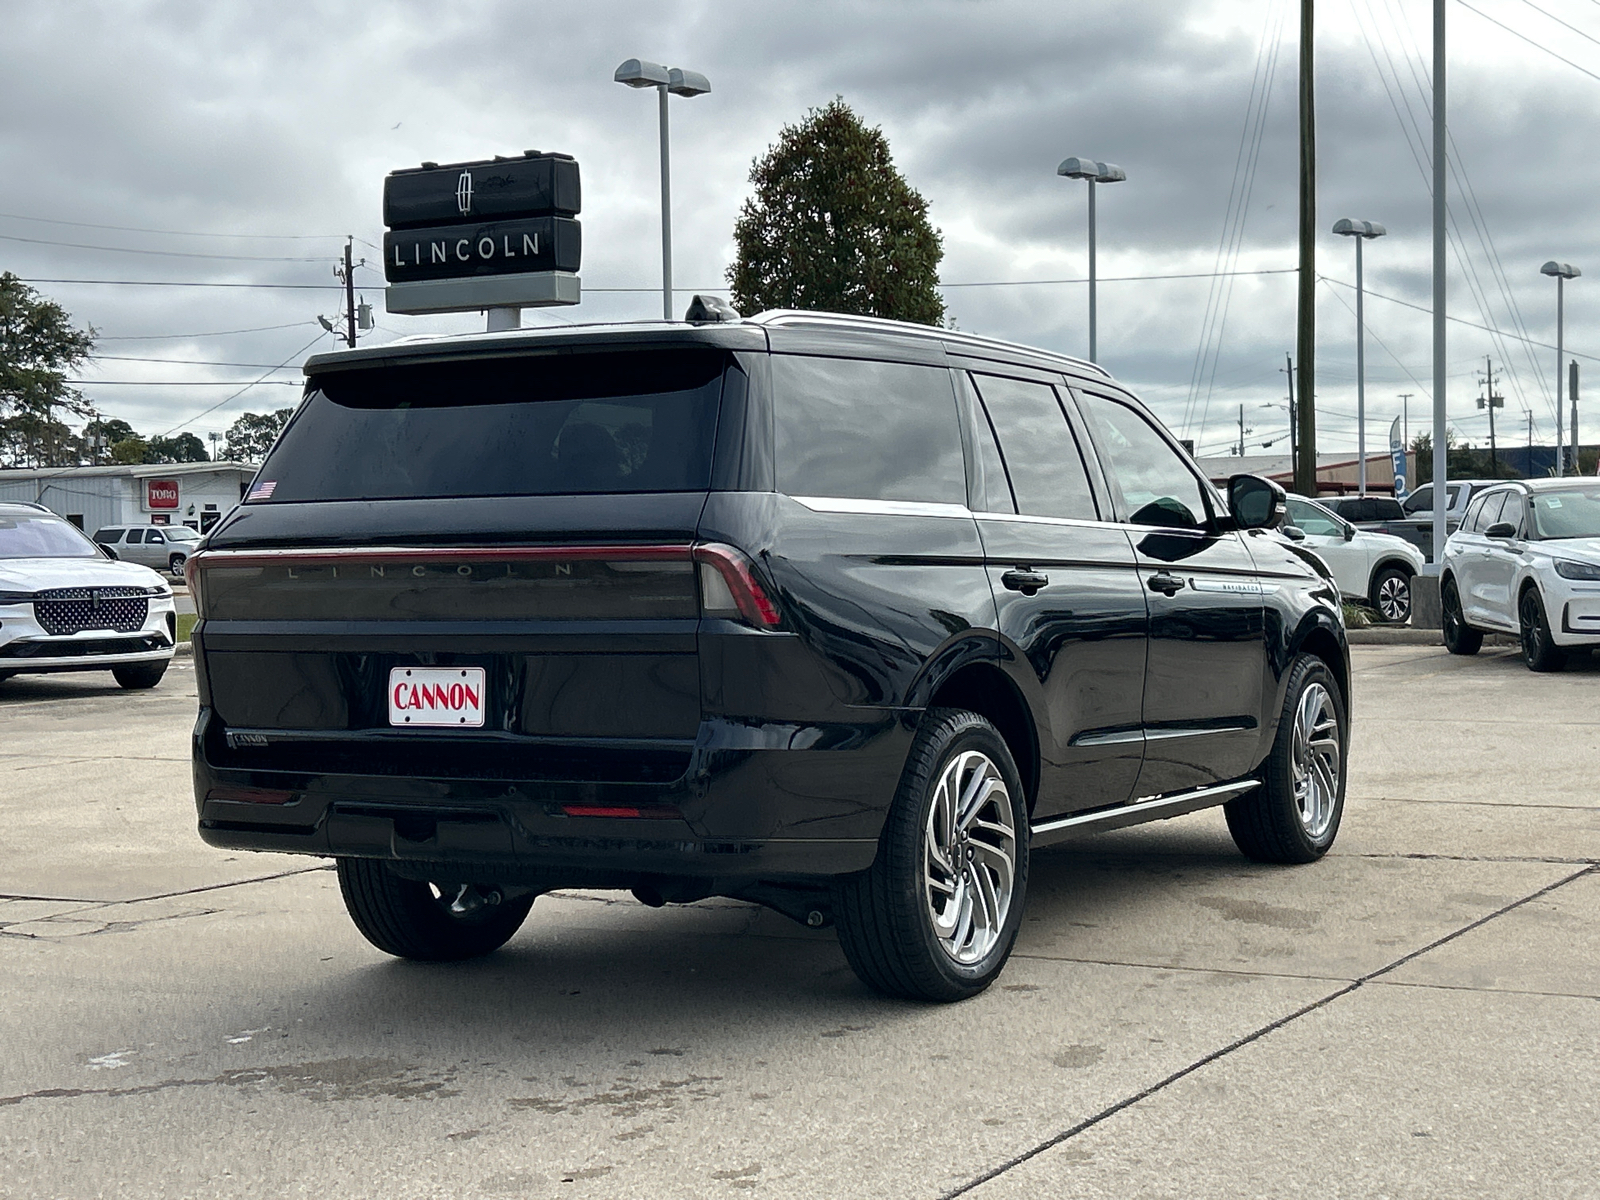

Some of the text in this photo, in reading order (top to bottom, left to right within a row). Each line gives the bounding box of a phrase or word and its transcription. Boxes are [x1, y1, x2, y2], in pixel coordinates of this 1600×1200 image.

[395, 233, 539, 266] LINCOLN
[150, 489, 177, 500] TORO
[288, 563, 571, 579] LINCOLN
[394, 682, 479, 711] CANNON
